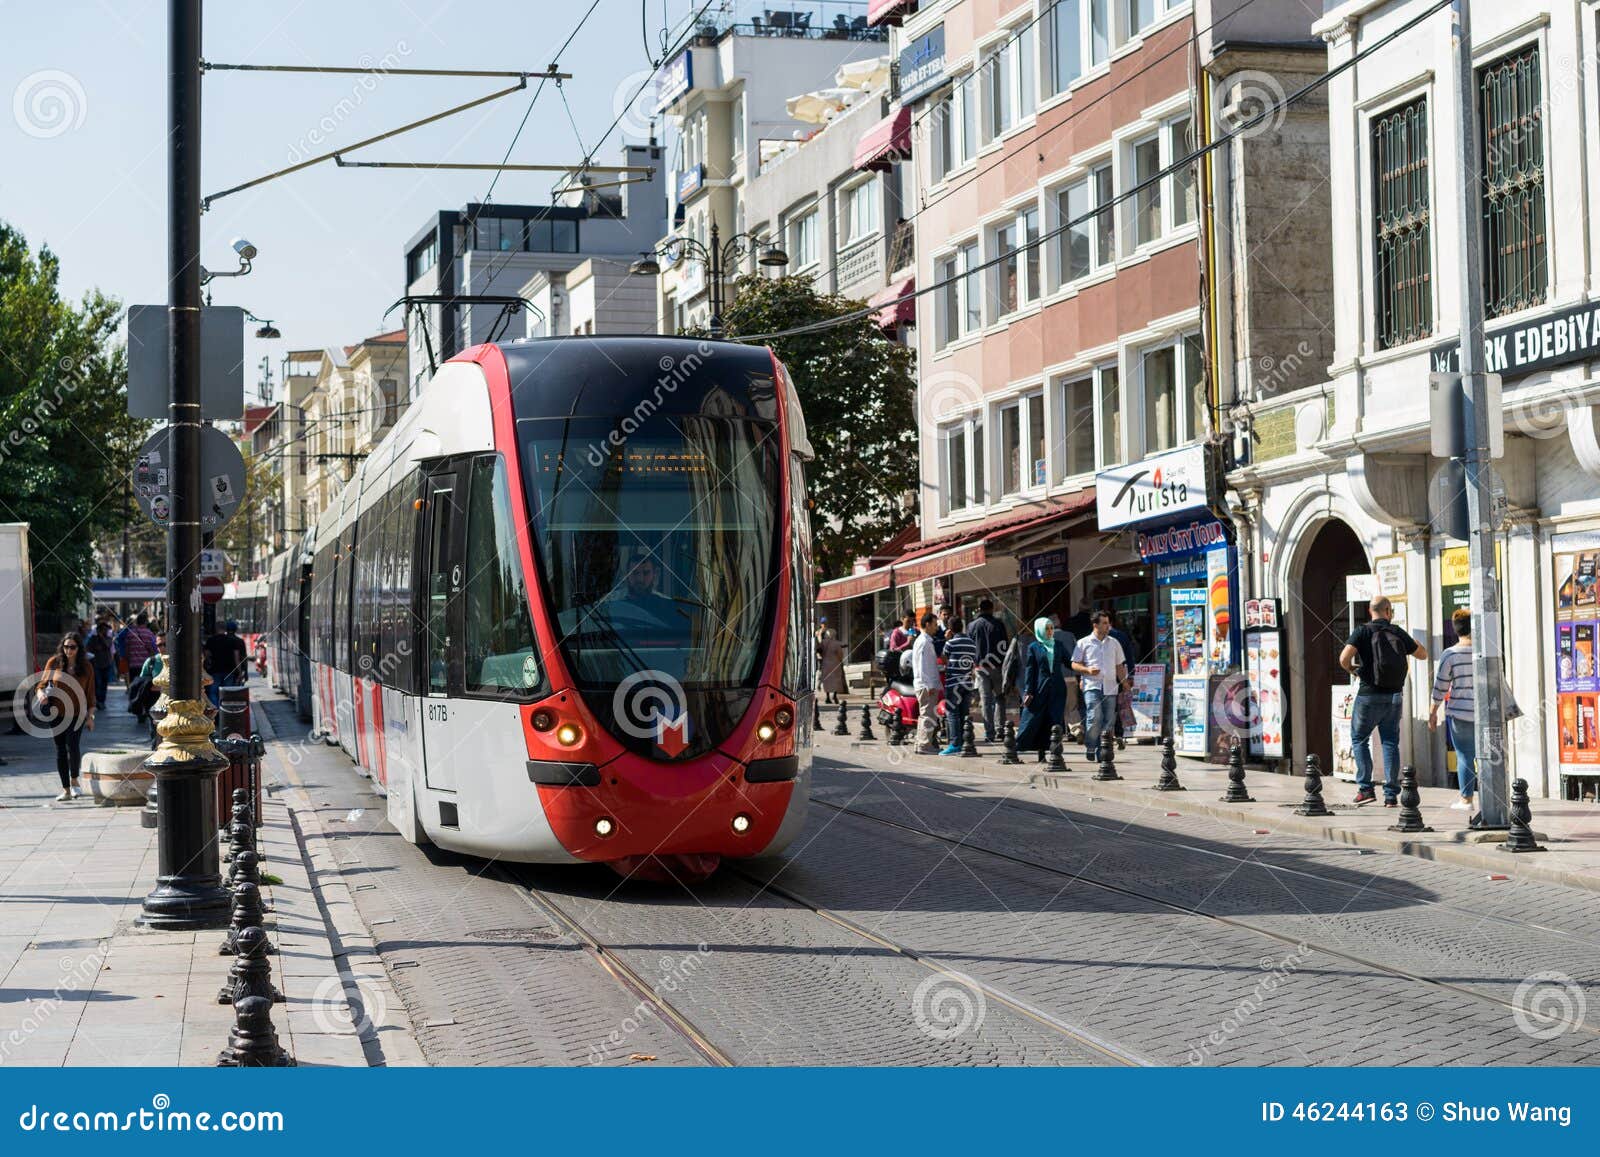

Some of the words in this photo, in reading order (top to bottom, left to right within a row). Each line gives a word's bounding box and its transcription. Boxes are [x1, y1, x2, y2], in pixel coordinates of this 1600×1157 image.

[1455, 334, 1508, 374] TRK
[1111, 467, 1187, 516] Turista
[1190, 521, 1226, 547] TOUR
[1189, 556, 1207, 575] Cruis
[428, 704, 448, 721] 817B
[656, 711, 689, 745] M
